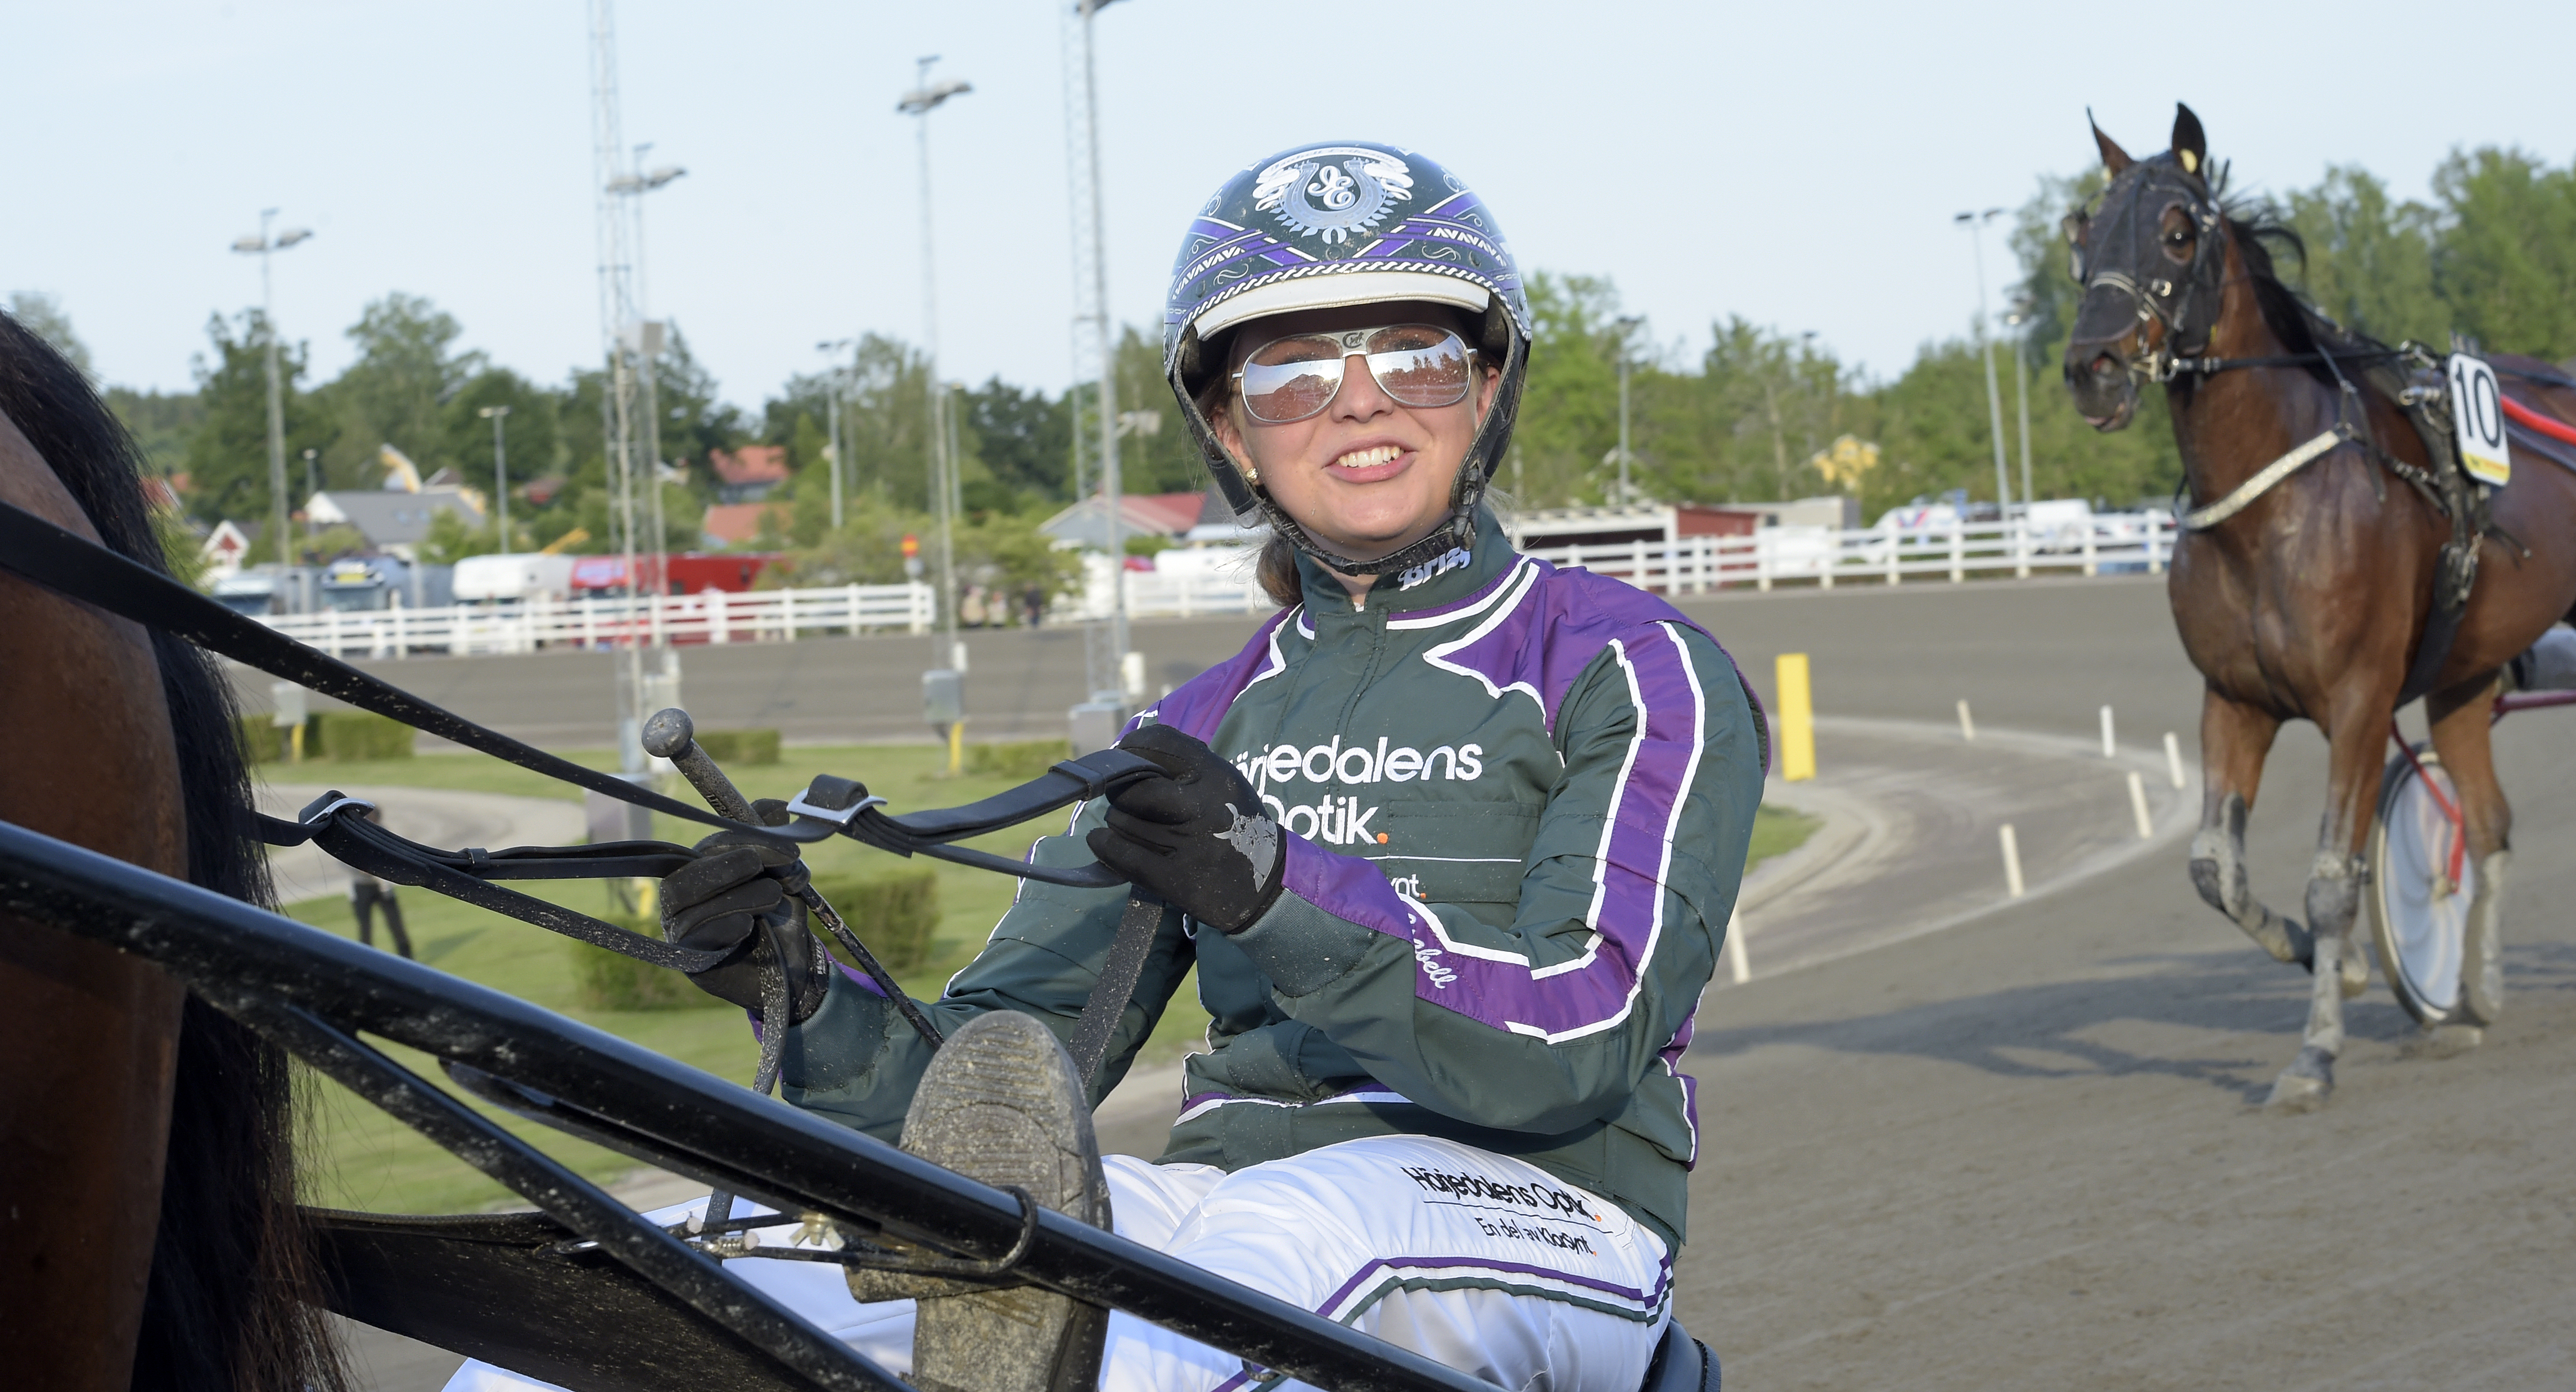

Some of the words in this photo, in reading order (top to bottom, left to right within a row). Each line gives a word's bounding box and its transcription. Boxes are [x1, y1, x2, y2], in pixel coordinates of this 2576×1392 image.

[2455, 363, 2501, 448] 10
[1229, 734, 1483, 799] ärjedalens
[1474, 1217, 1501, 1236] En
[1499, 1218, 1525, 1239] del
[1522, 1228, 1541, 1242] av
